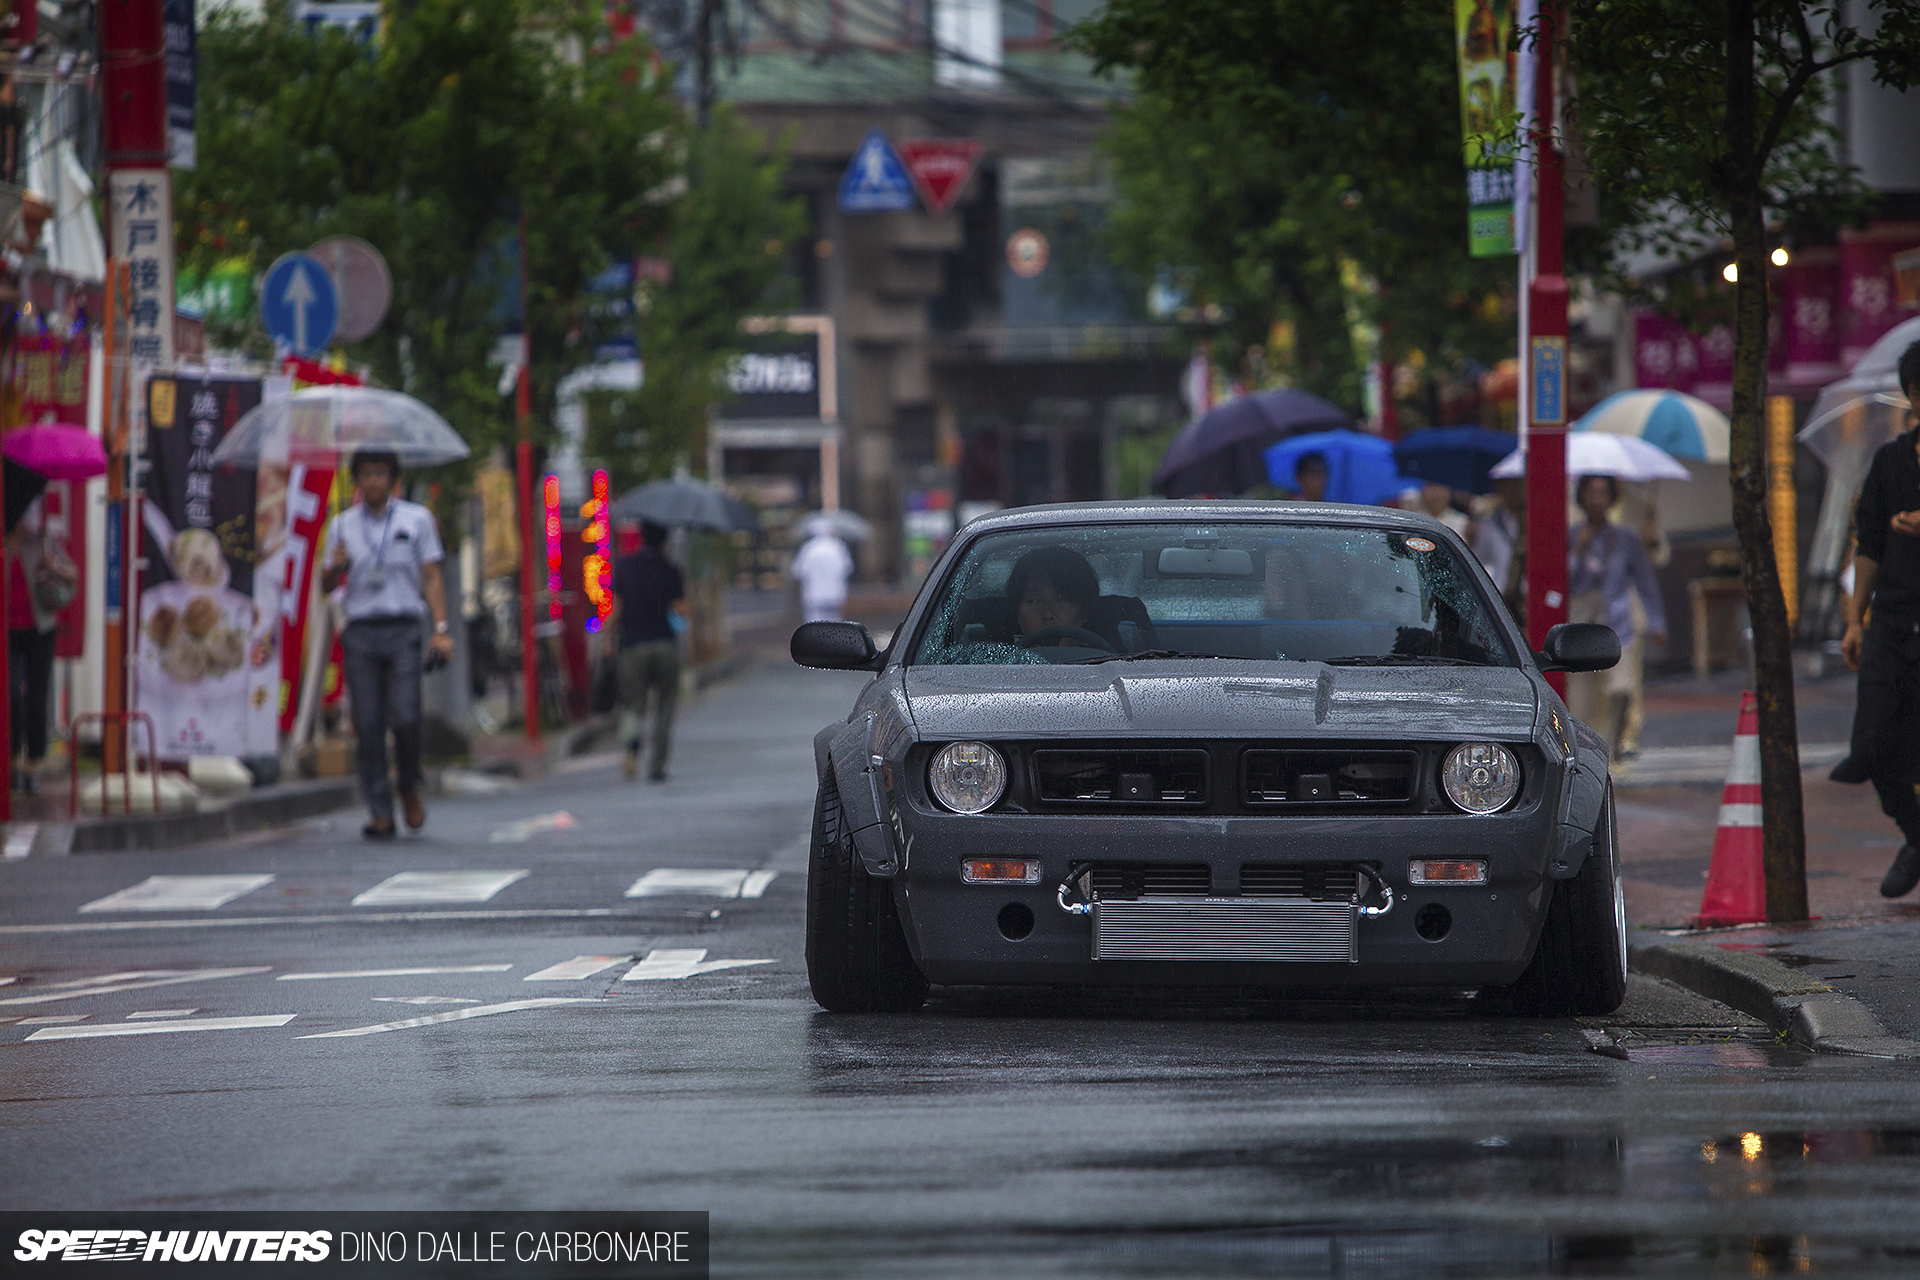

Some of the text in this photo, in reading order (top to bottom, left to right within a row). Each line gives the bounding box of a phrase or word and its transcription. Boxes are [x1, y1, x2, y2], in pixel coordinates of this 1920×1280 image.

[125, 179, 161, 369] 木戸接骨院
